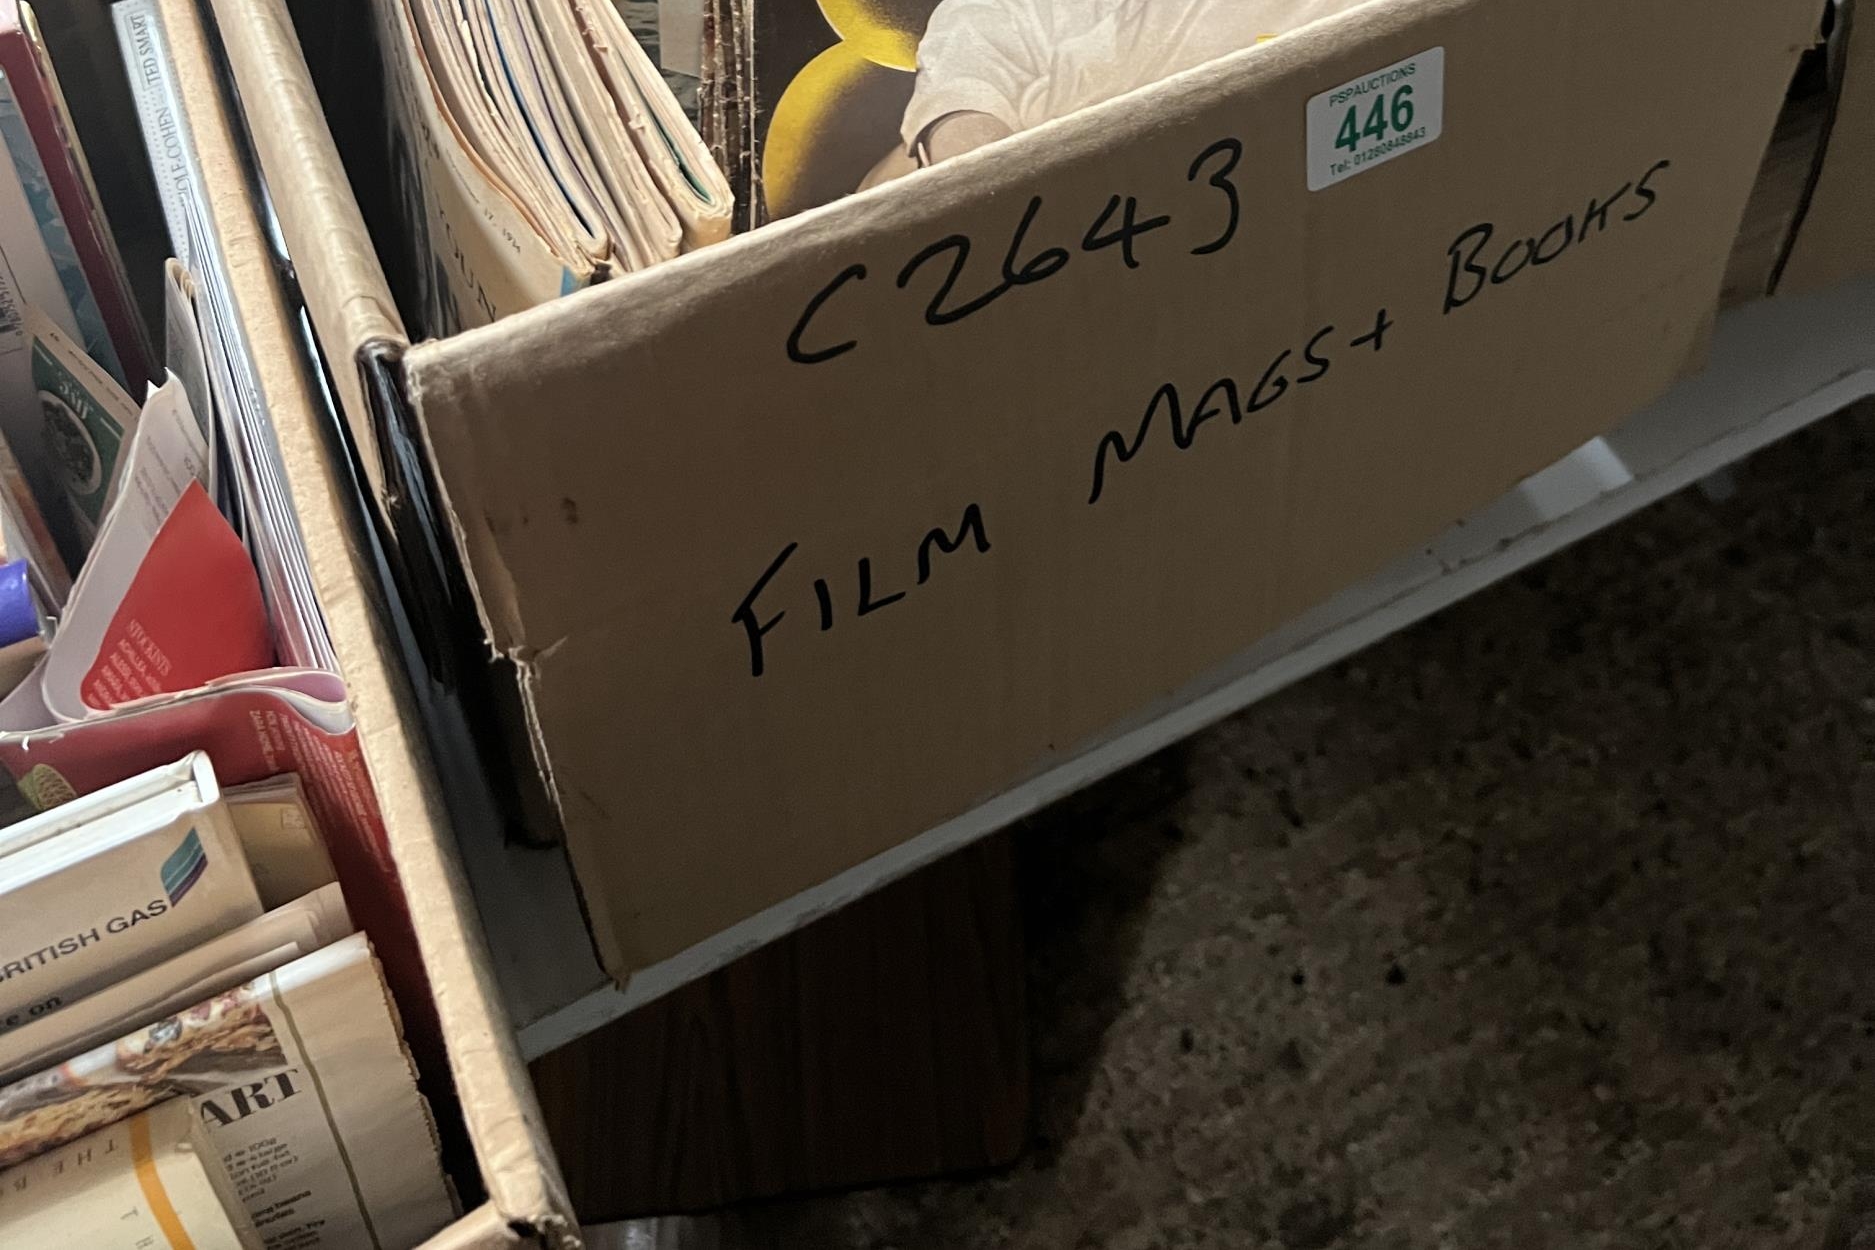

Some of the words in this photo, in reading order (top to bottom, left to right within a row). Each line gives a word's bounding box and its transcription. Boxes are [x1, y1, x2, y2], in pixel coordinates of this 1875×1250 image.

[131, 14, 153, 57] SMART
[143, 56, 161, 85] TED
[1334, 84, 1414, 152] 446
[731, 503, 991, 678] FILM
[1443, 160, 1670, 315] BOOKS
[127, 619, 172, 677] STOCKISTS
[0, 928, 101, 983] RITISH
[106, 899, 168, 934] GAS
[29, 996, 63, 1016] on
[201, 1069, 302, 1127] ART
